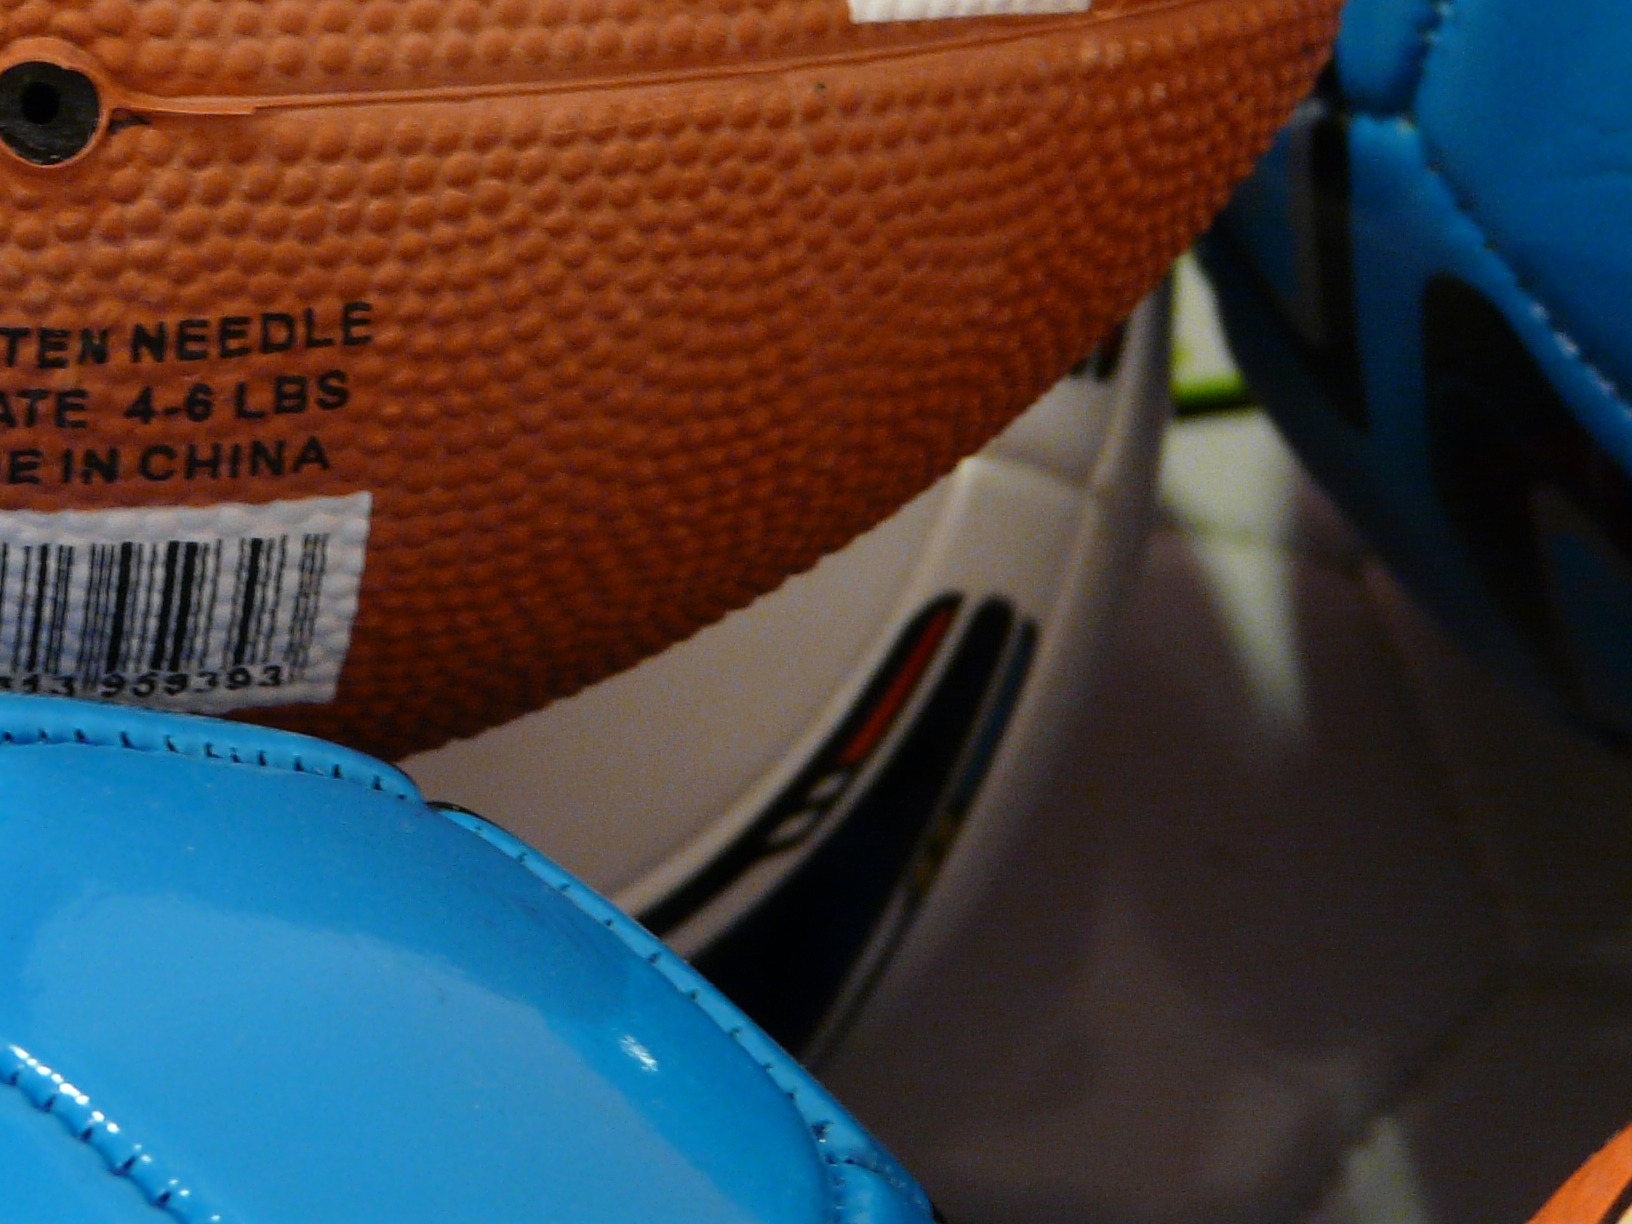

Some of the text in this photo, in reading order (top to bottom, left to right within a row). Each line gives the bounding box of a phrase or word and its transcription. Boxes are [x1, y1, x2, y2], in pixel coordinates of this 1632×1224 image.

[130, 302, 374, 362] NEEDLE
[124, 382, 216, 425] 4-6
[234, 369, 351, 420] LBS
[62, 446, 120, 485] IN
[138, 436, 332, 483] CHINA
